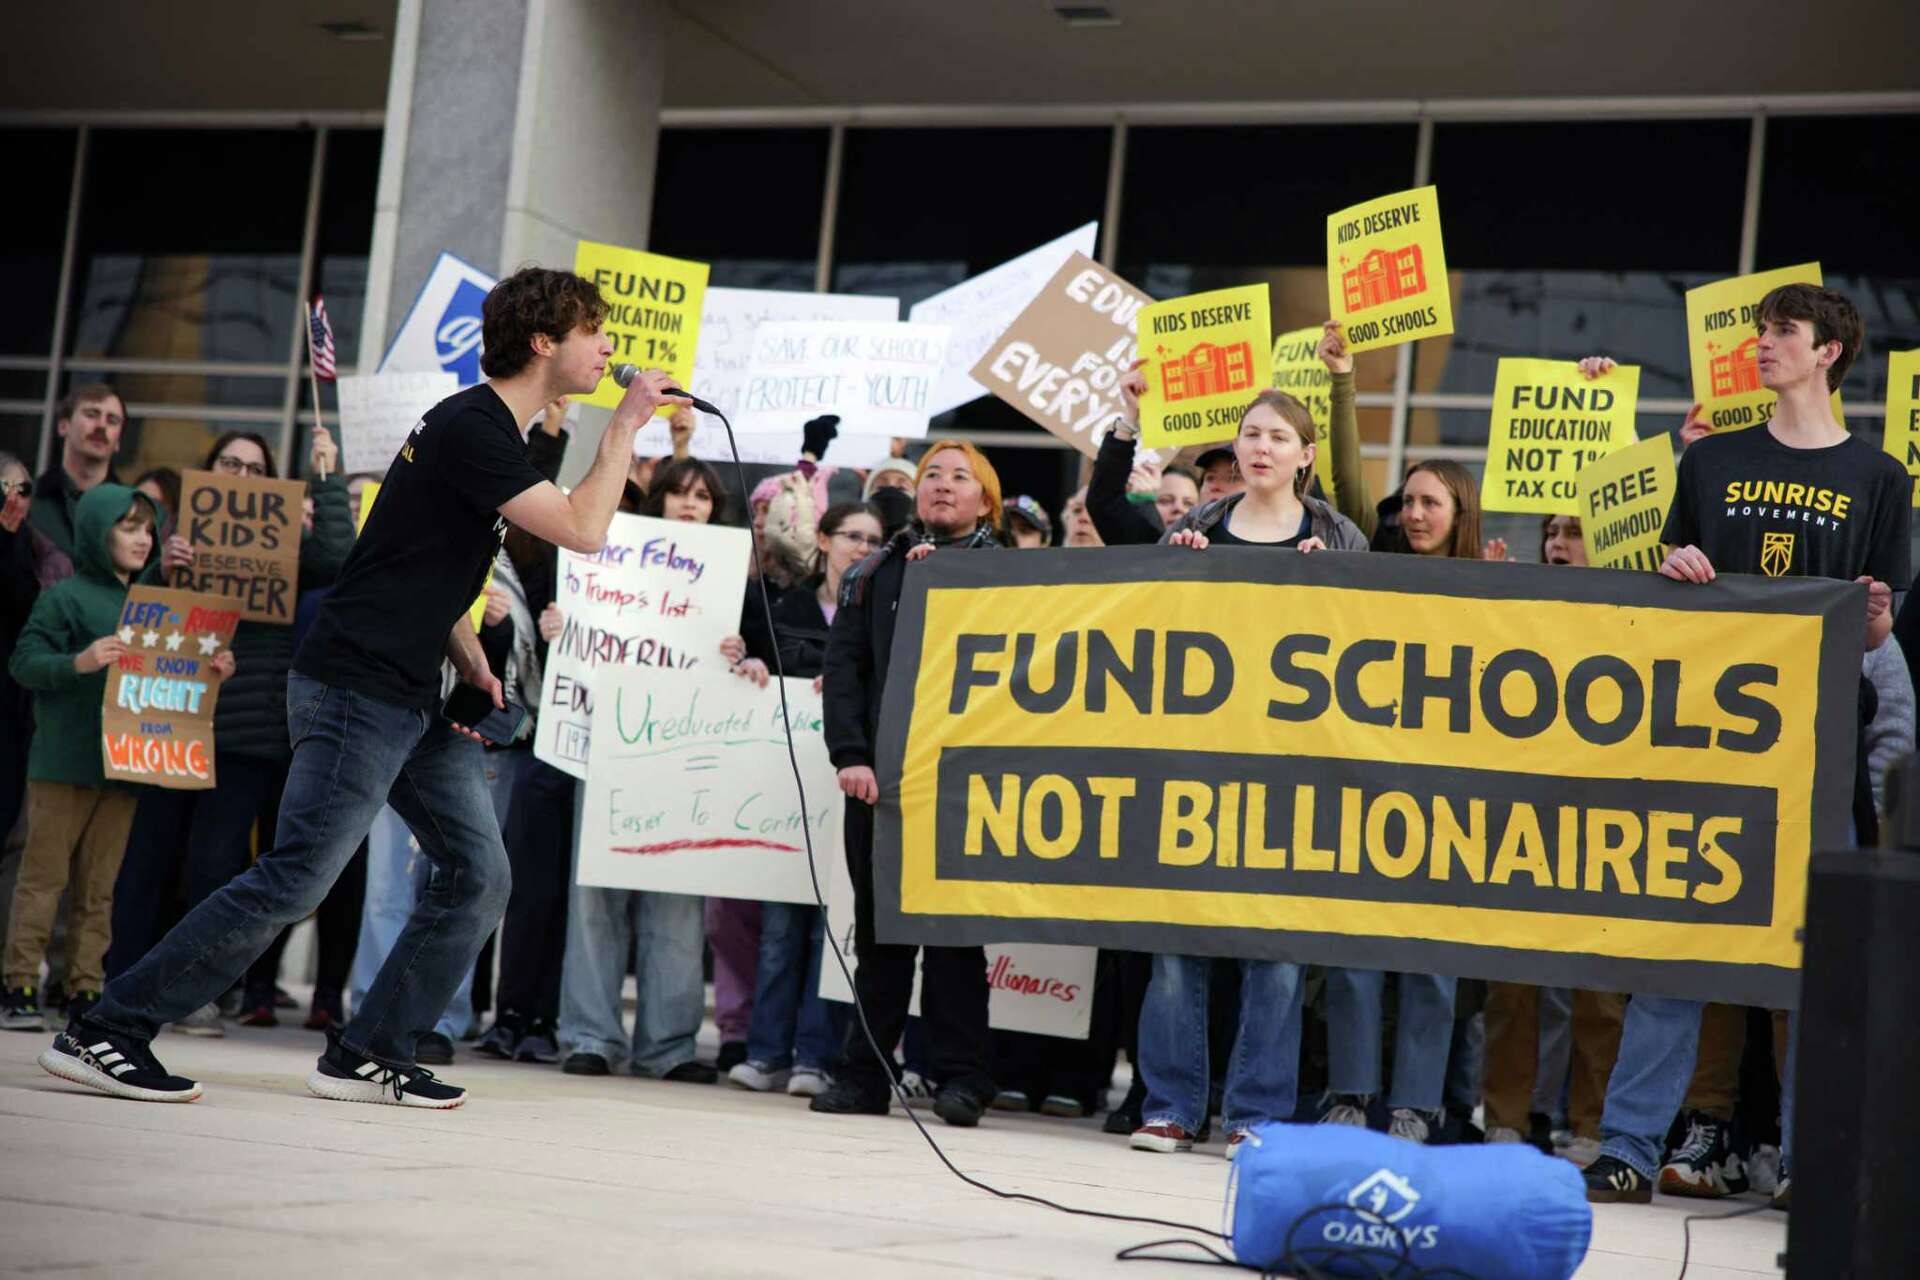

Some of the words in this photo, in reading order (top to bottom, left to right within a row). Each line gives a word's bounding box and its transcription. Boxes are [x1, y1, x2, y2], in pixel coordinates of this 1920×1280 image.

[1338, 219, 1361, 244] KIDS
[1364, 203, 1420, 236] DESERVE
[594, 268, 687, 304] FUND
[1065, 268, 1145, 334] EDU
[608, 302, 683, 335] UCATION
[1153, 313, 1187, 334] KIDS
[1191, 303, 1251, 329] DESERVE
[1347, 321, 1379, 344] GOOD
[1381, 306, 1437, 336] SCHOOLS
[1704, 305, 1736, 332] KIDS
[605, 331, 637, 356] OT
[646, 338, 677, 363] 1%
[1276, 340, 1318, 363] FUN
[746, 375, 840, 411] PROTECT
[865, 373, 929, 411] YOUTH
[1512, 386, 1615, 411] FUND
[1163, 411, 1202, 432] GOOD
[1509, 418, 1611, 442] EDUCATION
[1712, 408, 1751, 428] GOOD
[1506, 448, 1562, 471] NOT
[190, 486, 289, 526] OUR
[1505, 480, 1544, 498] TAX
[1552, 481, 1577, 498] CU
[1589, 466, 1658, 518] FREE
[1724, 480, 1851, 520] SUNRISE
[190, 517, 280, 550] KIDS
[1593, 506, 1661, 555] MAHMOUD
[1727, 506, 1840, 532] MOVEMENT
[640, 537, 705, 584] Felony
[565, 561, 581, 593] to
[585, 571, 649, 616] Trump's
[123, 601, 171, 628] LEFT
[184, 605, 241, 635] RIGHT
[118, 655, 145, 673] WE
[155, 656, 199, 676] KNOW
[118, 674, 208, 714] RIGHT
[552, 672, 595, 716] EDU
[948, 628, 1234, 715] FUND
[1267, 634, 1782, 754] SCHOOLS
[140, 722, 173, 735] FROM
[104, 732, 210, 780] WRONG
[691, 788, 711, 826] To
[964, 773, 1136, 859] NOT
[1158, 778, 1744, 906] BILLIONAIRES
[1322, 1221, 1440, 1250] OASKYS
